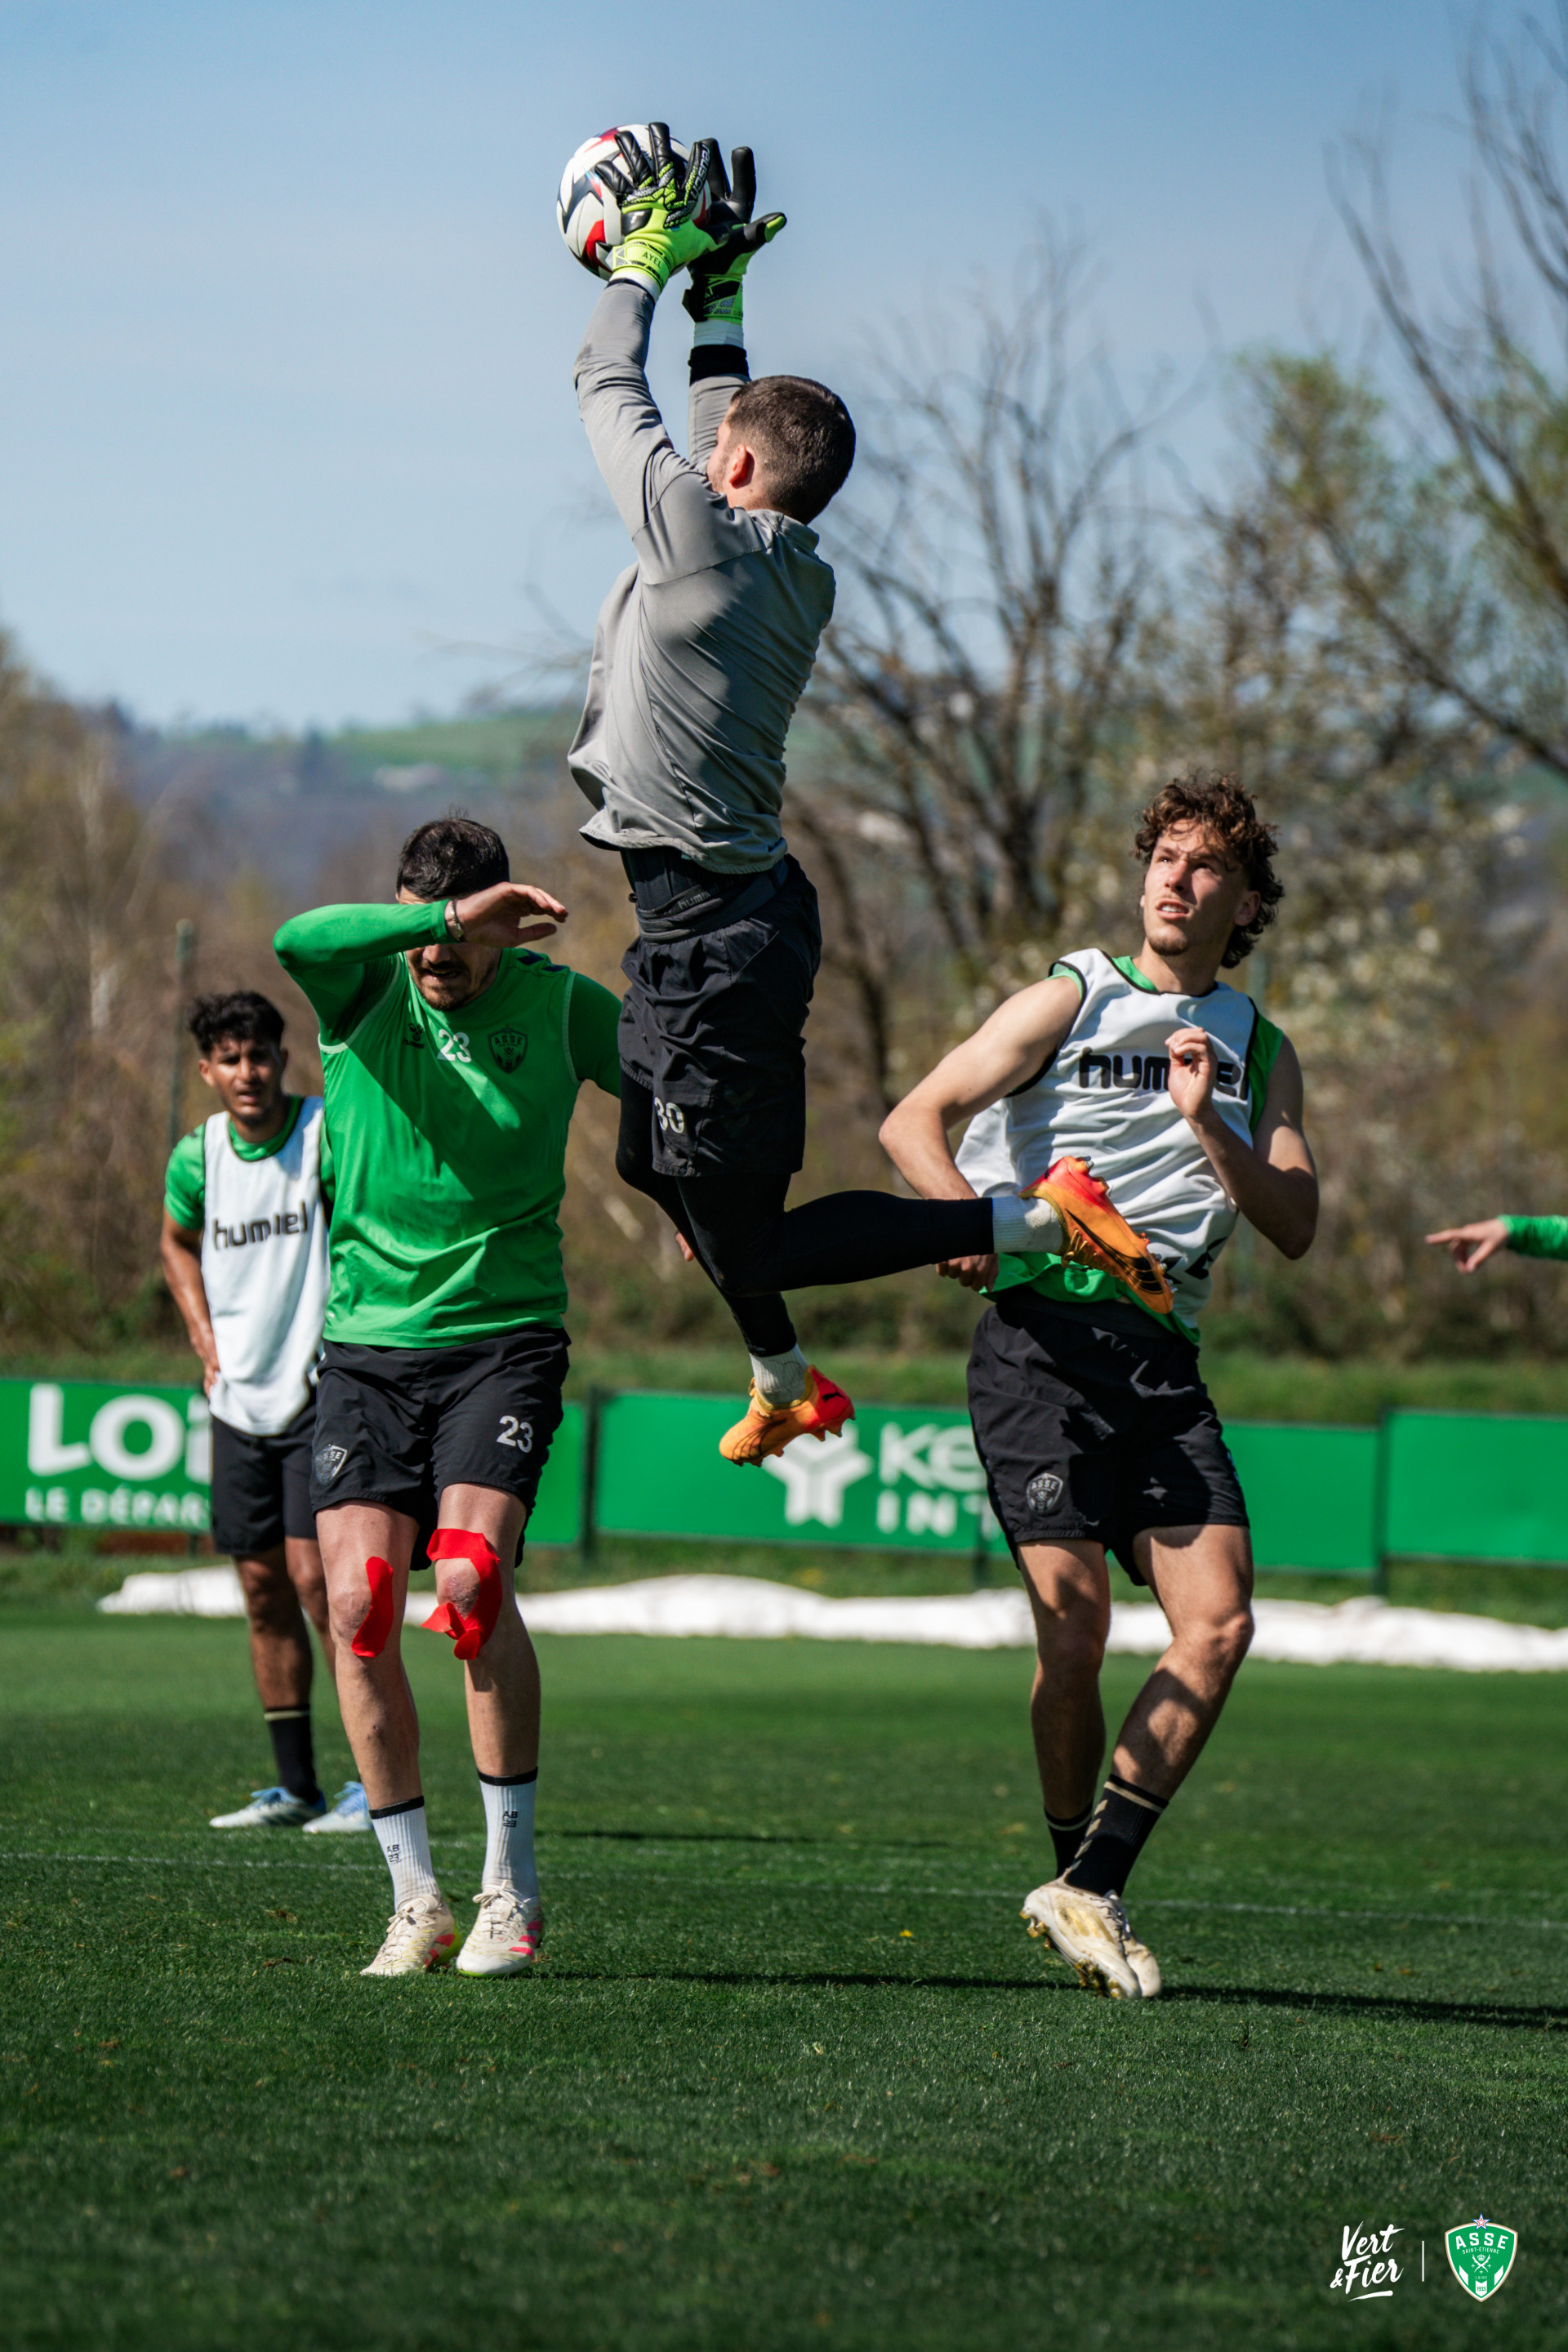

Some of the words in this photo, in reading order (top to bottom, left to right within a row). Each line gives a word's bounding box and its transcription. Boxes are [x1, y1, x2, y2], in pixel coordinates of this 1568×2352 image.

[437, 1029, 471, 1062] 23
[494, 1034, 523, 1046] ASSE
[1079, 1047, 1250, 1101] humel
[654, 1097, 684, 1134] 30
[496, 1415, 533, 1454] 23
[1031, 1479, 1058, 1490] ASSE
[25, 1487, 69, 1522] LE
